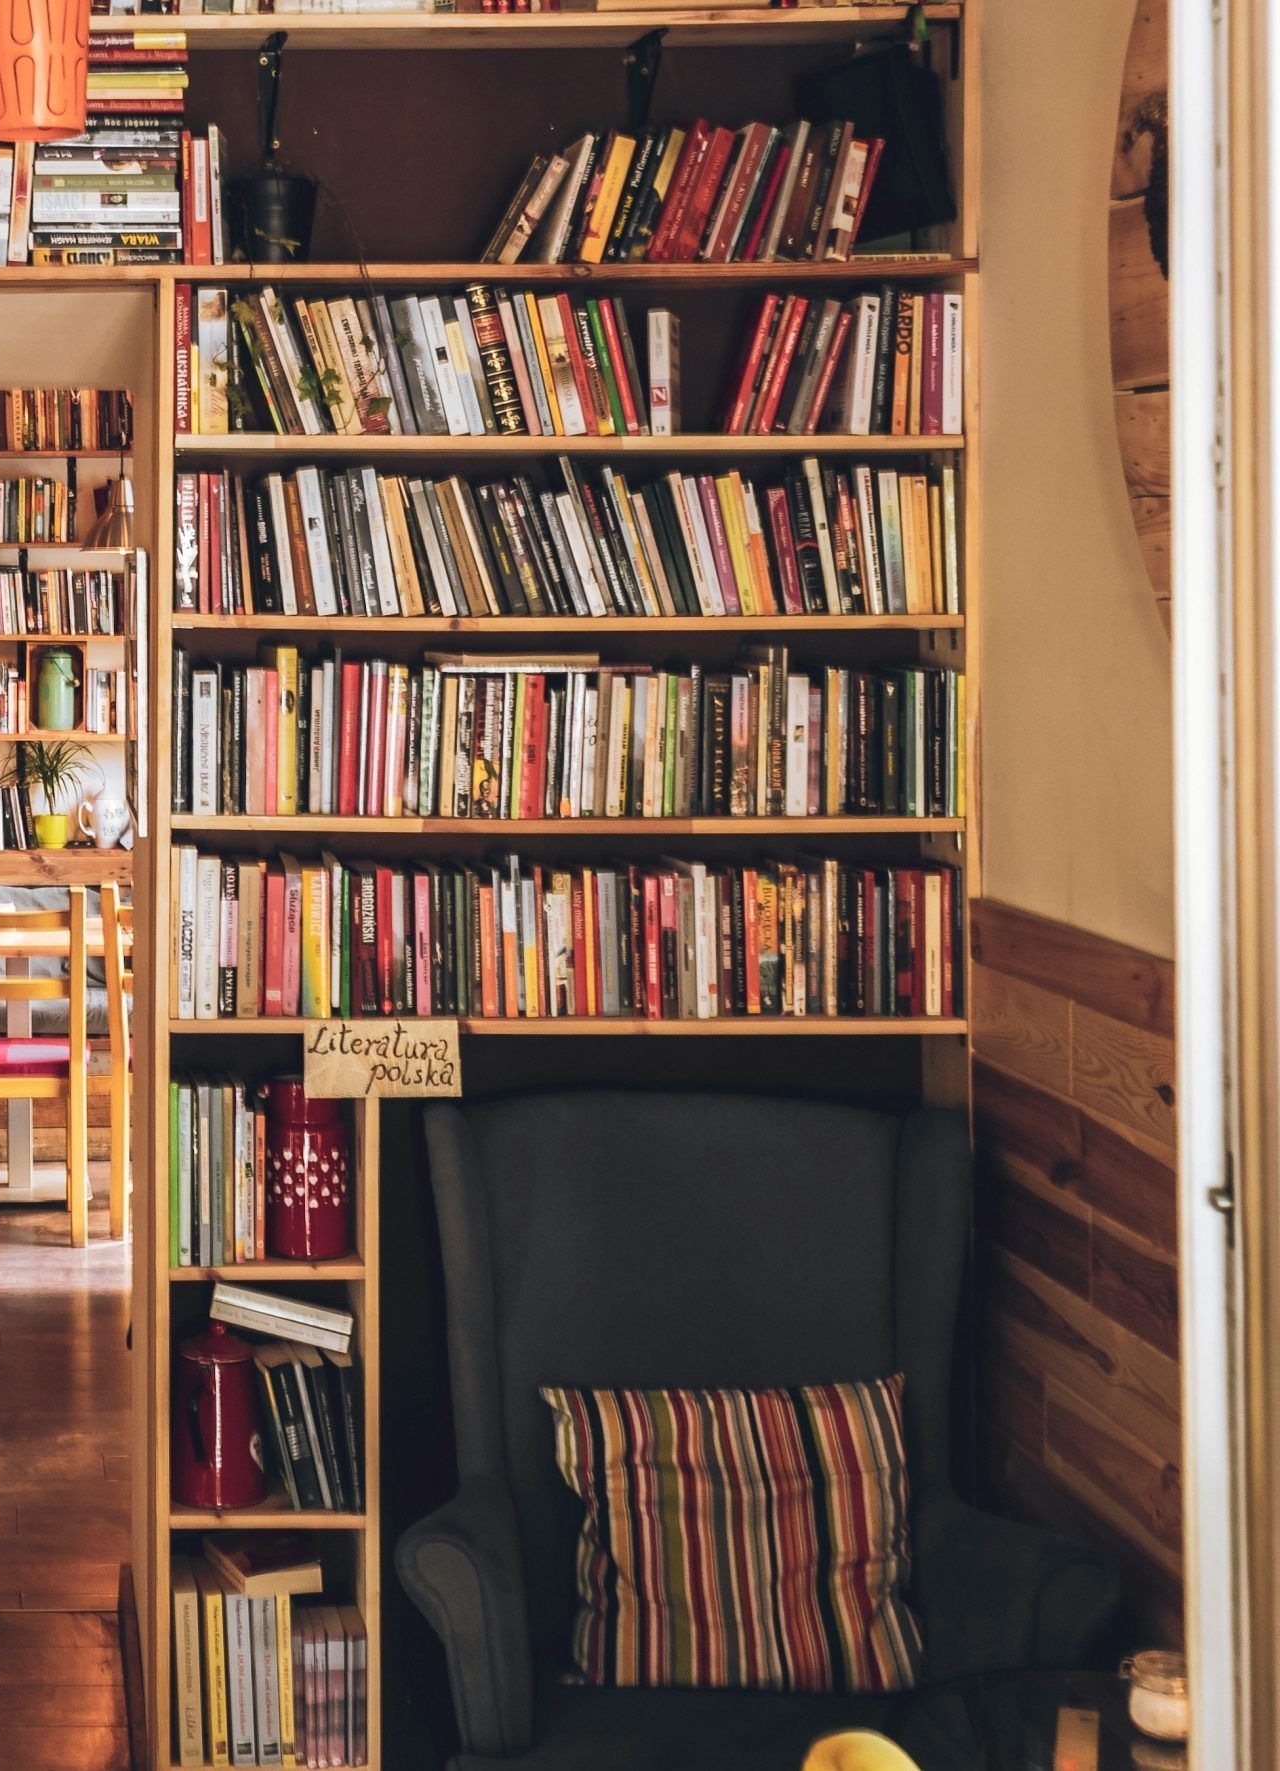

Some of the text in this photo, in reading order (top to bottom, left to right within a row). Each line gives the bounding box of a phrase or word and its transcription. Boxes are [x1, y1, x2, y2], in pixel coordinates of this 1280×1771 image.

[104, 117, 122, 126] Noc
[630, 138, 653, 188] Paul Garrison
[50, 234, 161, 245] WIARA JENNIFER HAIGH
[175, 296, 184, 346] KOSMOWSKA
[884, 291, 894, 315] Andrzej
[896, 291, 913, 356] BARDO
[257, 521, 267, 544] BONDA
[799, 511, 812, 538] KOZAK
[310, 875, 325, 937] KARPOWICZ
[362, 884, 377, 943] ROGOZIŃSKI
[573, 890, 583, 940] Listy miłosne
[181, 909, 193, 961] KACZOR
[307, 1023, 448, 1062] Literatura
[365, 1060, 455, 1095] polska
